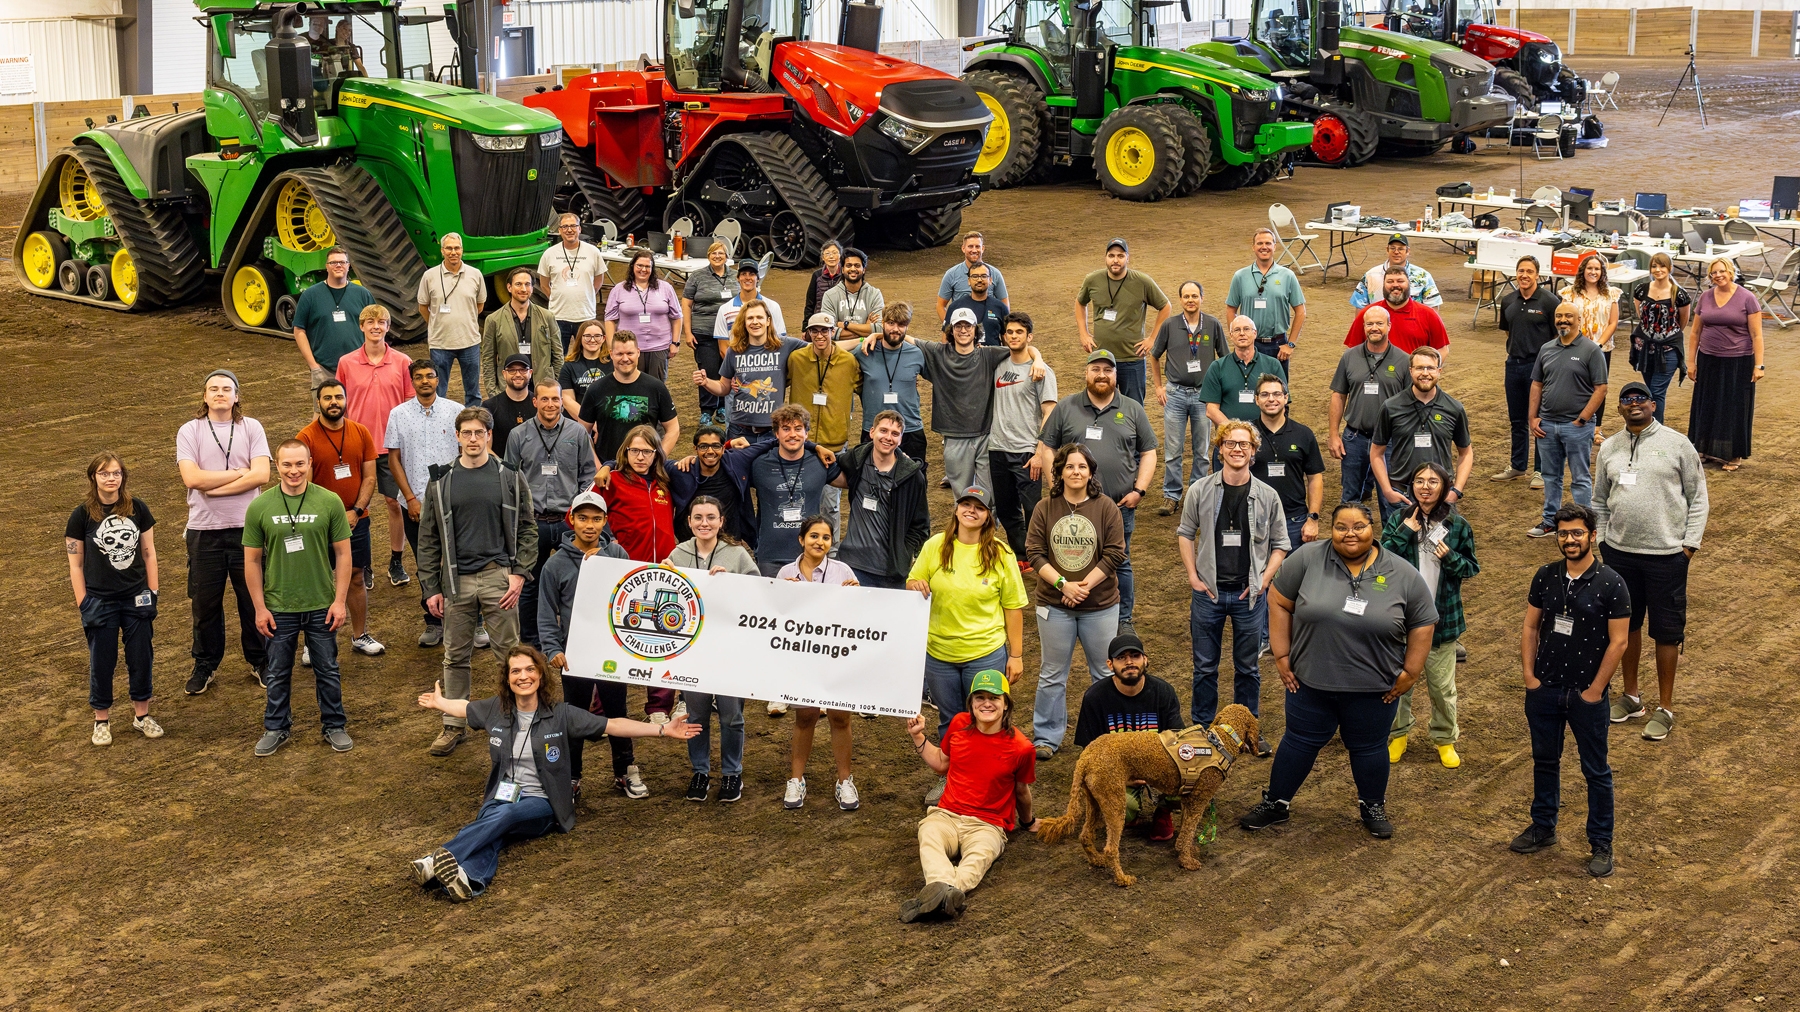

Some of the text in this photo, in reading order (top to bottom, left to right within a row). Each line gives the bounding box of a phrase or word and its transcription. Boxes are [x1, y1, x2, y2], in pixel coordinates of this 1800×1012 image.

[0, 56, 29, 64] WARNING
[341, 94, 367, 104] JOHN DEERE
[849, 104, 863, 118] 715
[399, 122, 446, 132] 640 9RX
[943, 138, 960, 147] CASE
[840, 298, 867, 312] PUMA
[735, 352, 780, 368] TACOCAT
[1000, 370, 1020, 383] NIKE
[736, 399, 776, 414] TACOCAT
[271, 514, 319, 525] FENDT
[1053, 534, 1094, 546] GUINNESS
[623, 571, 694, 602] CYBERTRACTOR
[738, 614, 888, 642] 2024 CyberTractor
[624, 634, 678, 654] CHALLLENGE
[672, 675, 699, 684] AGCO
[818, 699, 856, 710] containing
[879, 706, 897, 714] more
